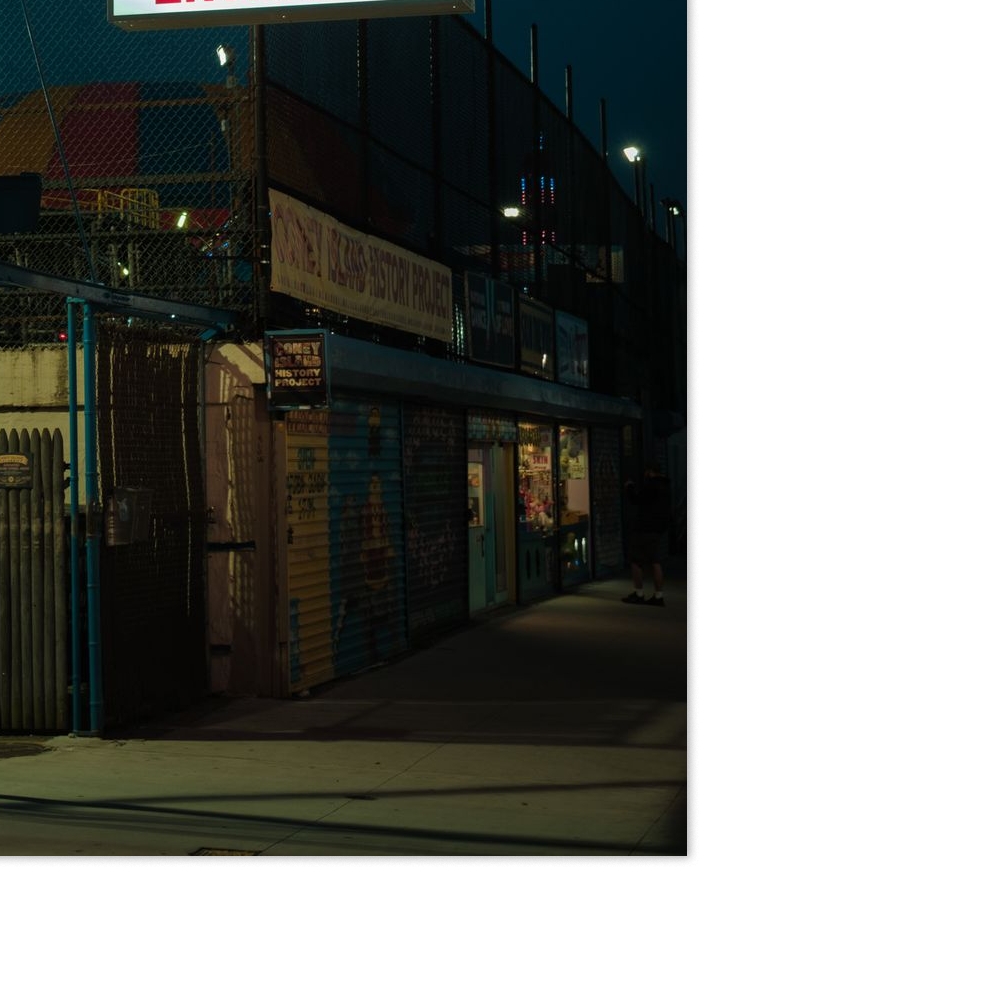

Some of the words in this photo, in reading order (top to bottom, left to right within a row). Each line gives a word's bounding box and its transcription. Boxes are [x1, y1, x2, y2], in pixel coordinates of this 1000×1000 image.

[369, 244, 411, 308] HISTORY
[412, 261, 451, 320] PROJECT
[274, 368, 322, 378] HISTORY
[274, 378, 323, 387] PROJECT
